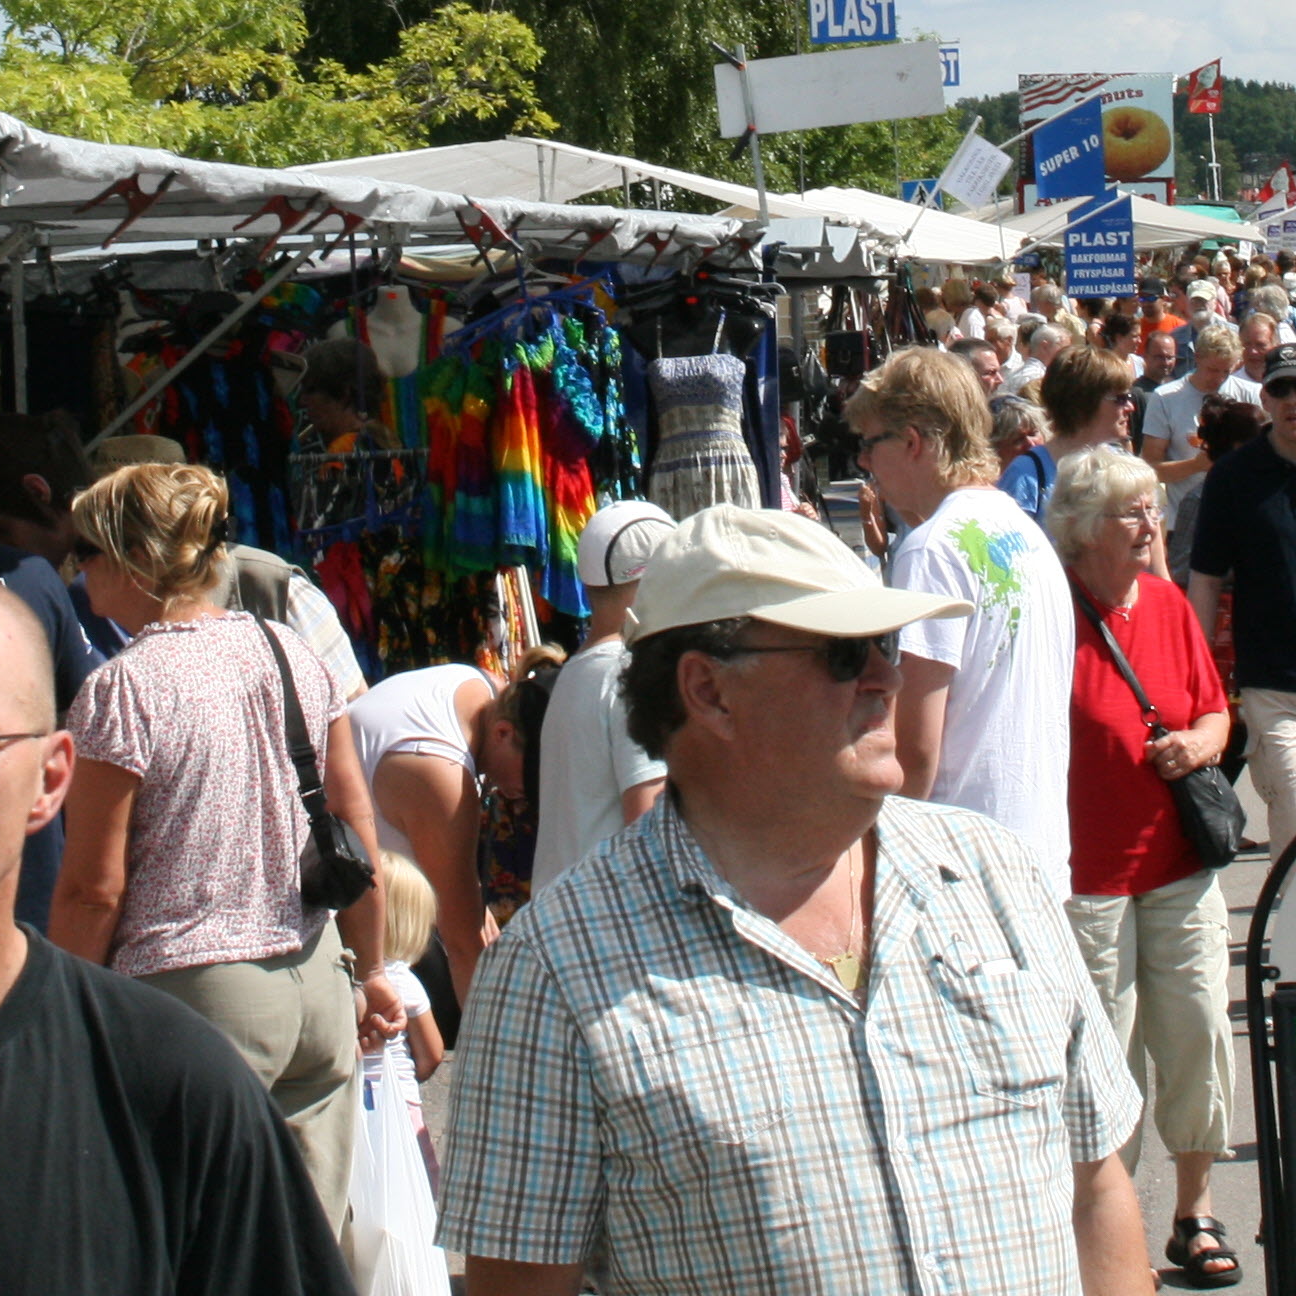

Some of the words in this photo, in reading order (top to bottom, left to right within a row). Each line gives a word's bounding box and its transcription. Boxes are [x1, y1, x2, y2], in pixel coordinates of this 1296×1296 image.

[1039, 145, 1080, 177] SUPER
[1082, 134, 1100, 153] 10
[1068, 231, 1131, 247] PLAST
[1071, 253, 1127, 264] BAKFORMAR
[1073, 267, 1126, 279] FRYSPÅSAR
[1068, 282, 1134, 295] AVFALLSPÅSAR
